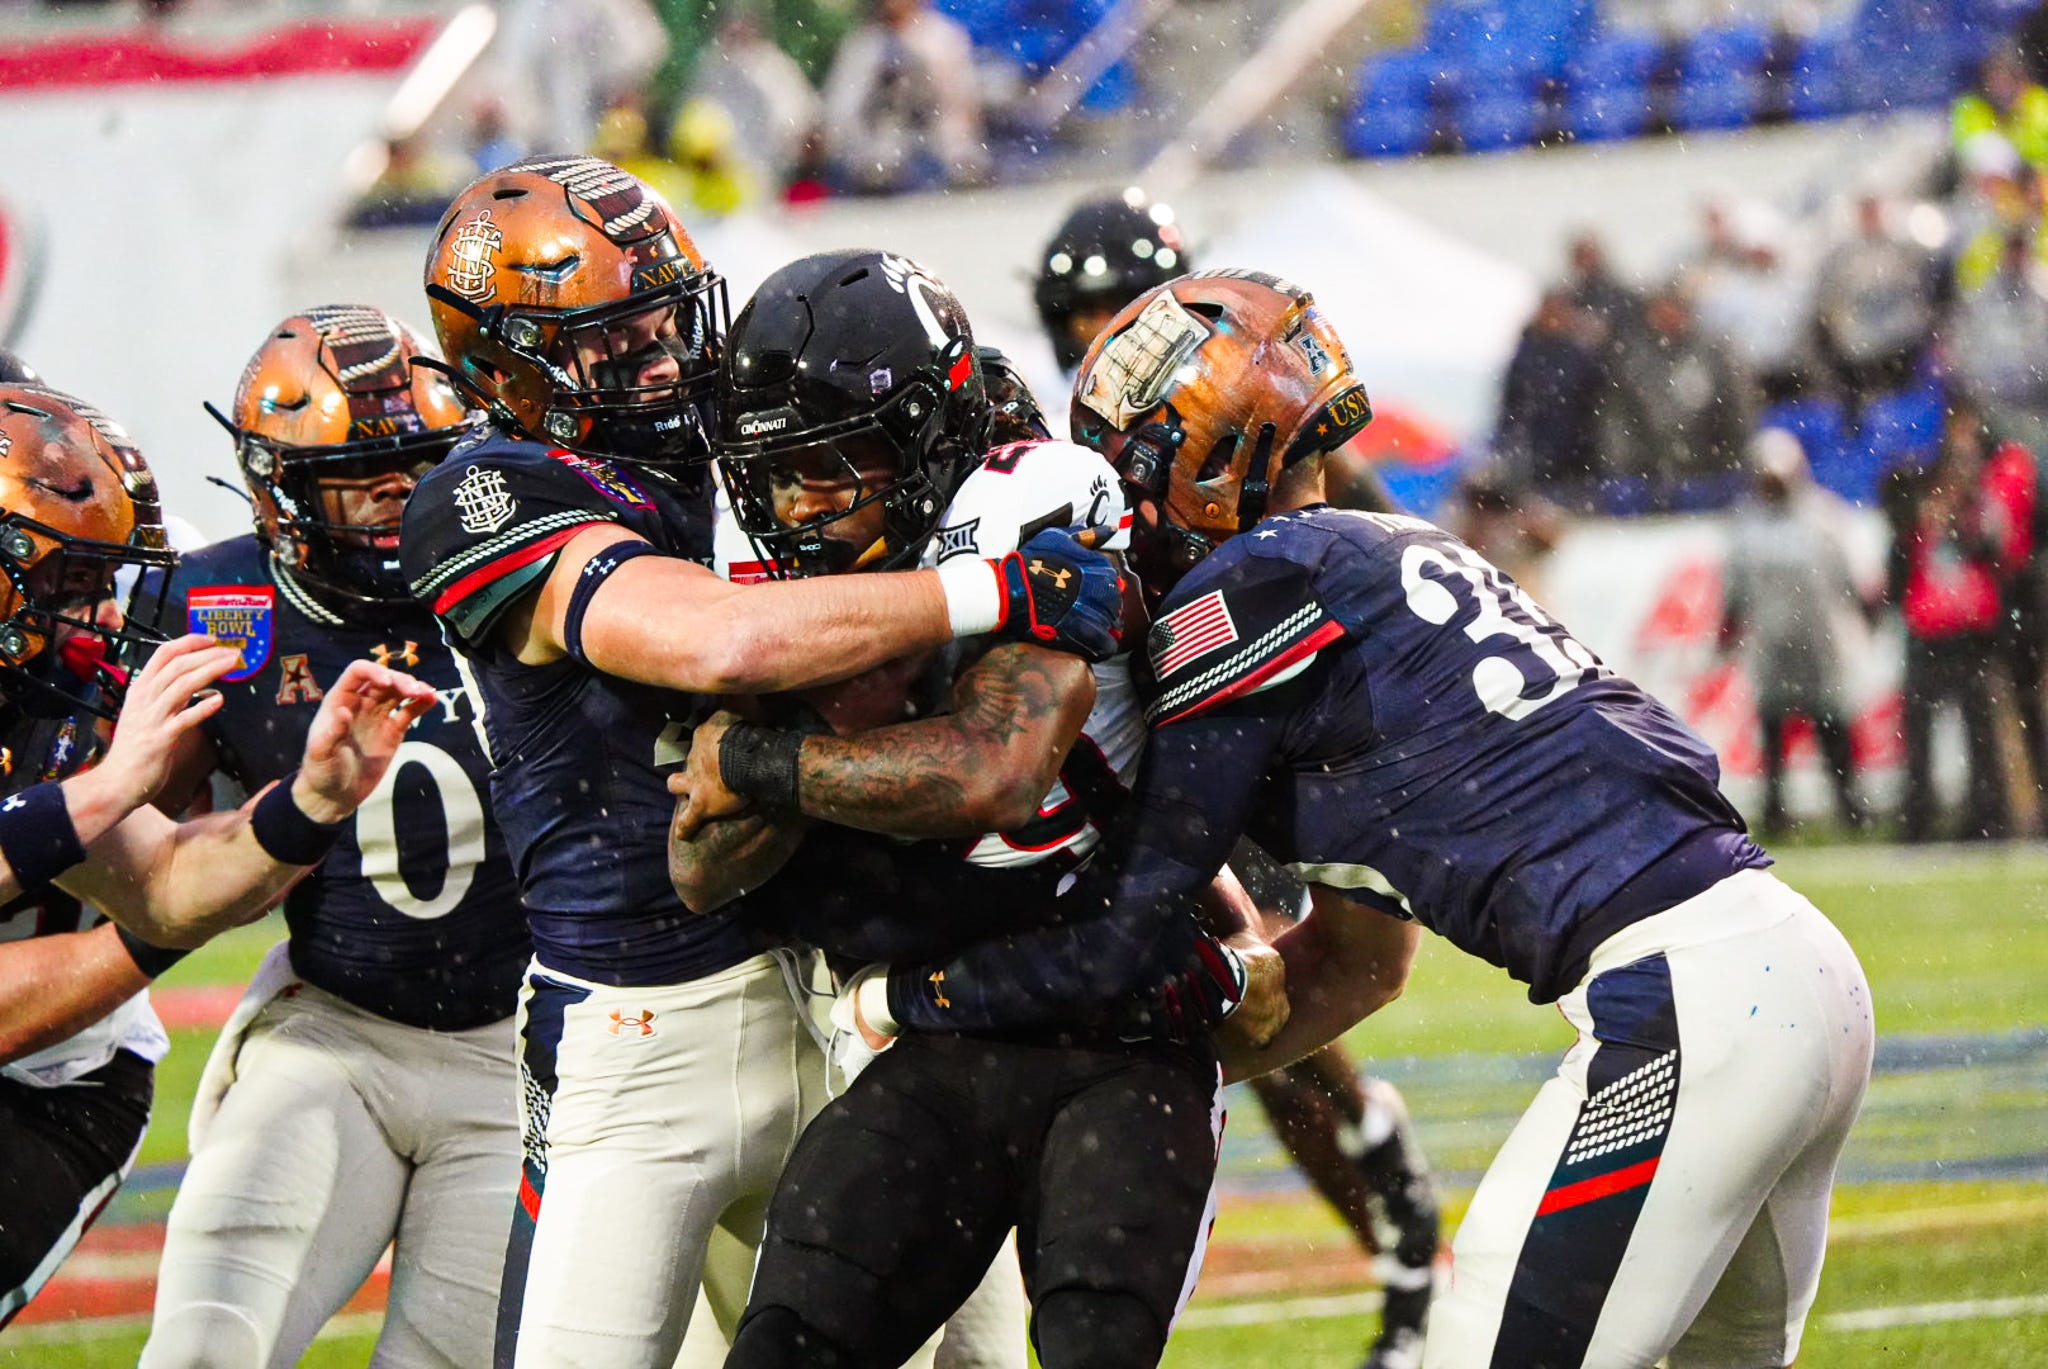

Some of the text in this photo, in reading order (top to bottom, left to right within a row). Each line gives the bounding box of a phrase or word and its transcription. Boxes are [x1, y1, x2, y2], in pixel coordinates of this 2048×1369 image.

[740, 418, 787, 435] CINCINNATI
[198, 609, 264, 621] LIBERTY
[207, 620, 256, 640] BOWL
[356, 741, 486, 920] 0
